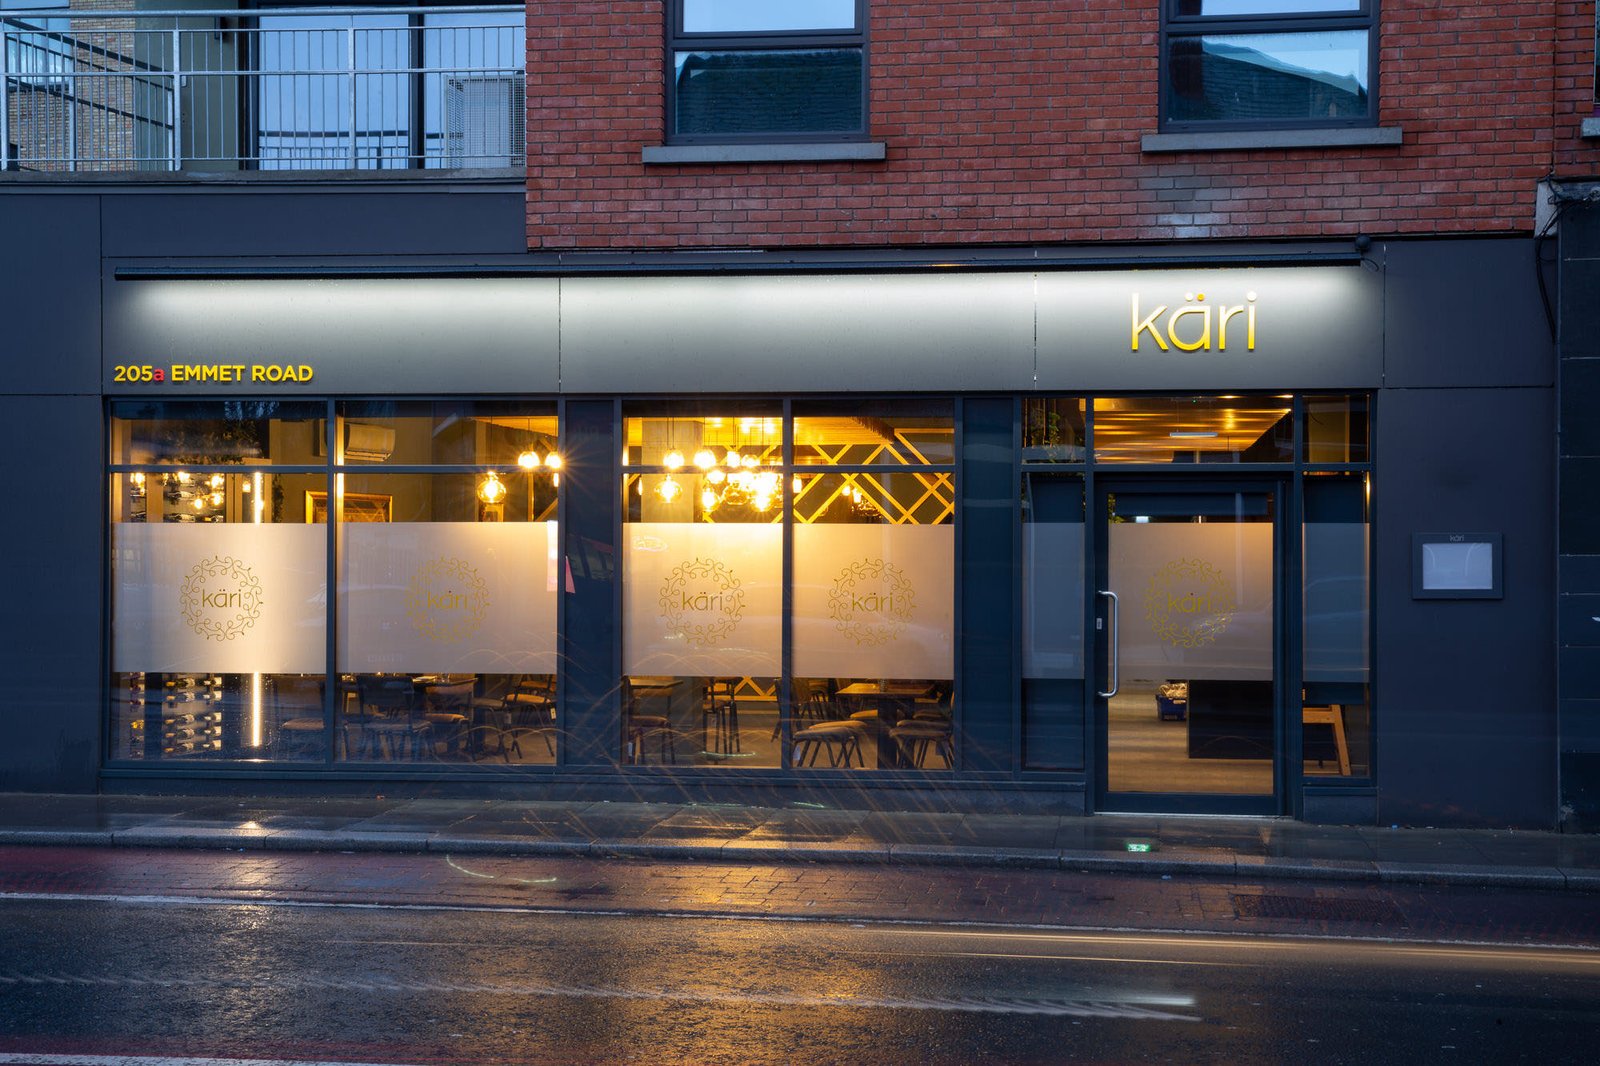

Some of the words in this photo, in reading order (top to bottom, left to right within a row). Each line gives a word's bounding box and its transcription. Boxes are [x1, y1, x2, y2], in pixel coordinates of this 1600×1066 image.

[1131, 291, 1257, 350] käri
[113, 365, 165, 382] 205a
[171, 365, 245, 382] EMMET
[252, 365, 314, 382] ROAD
[202, 588, 242, 608] käri
[682, 591, 723, 611] käri
[852, 592, 893, 612] käri
